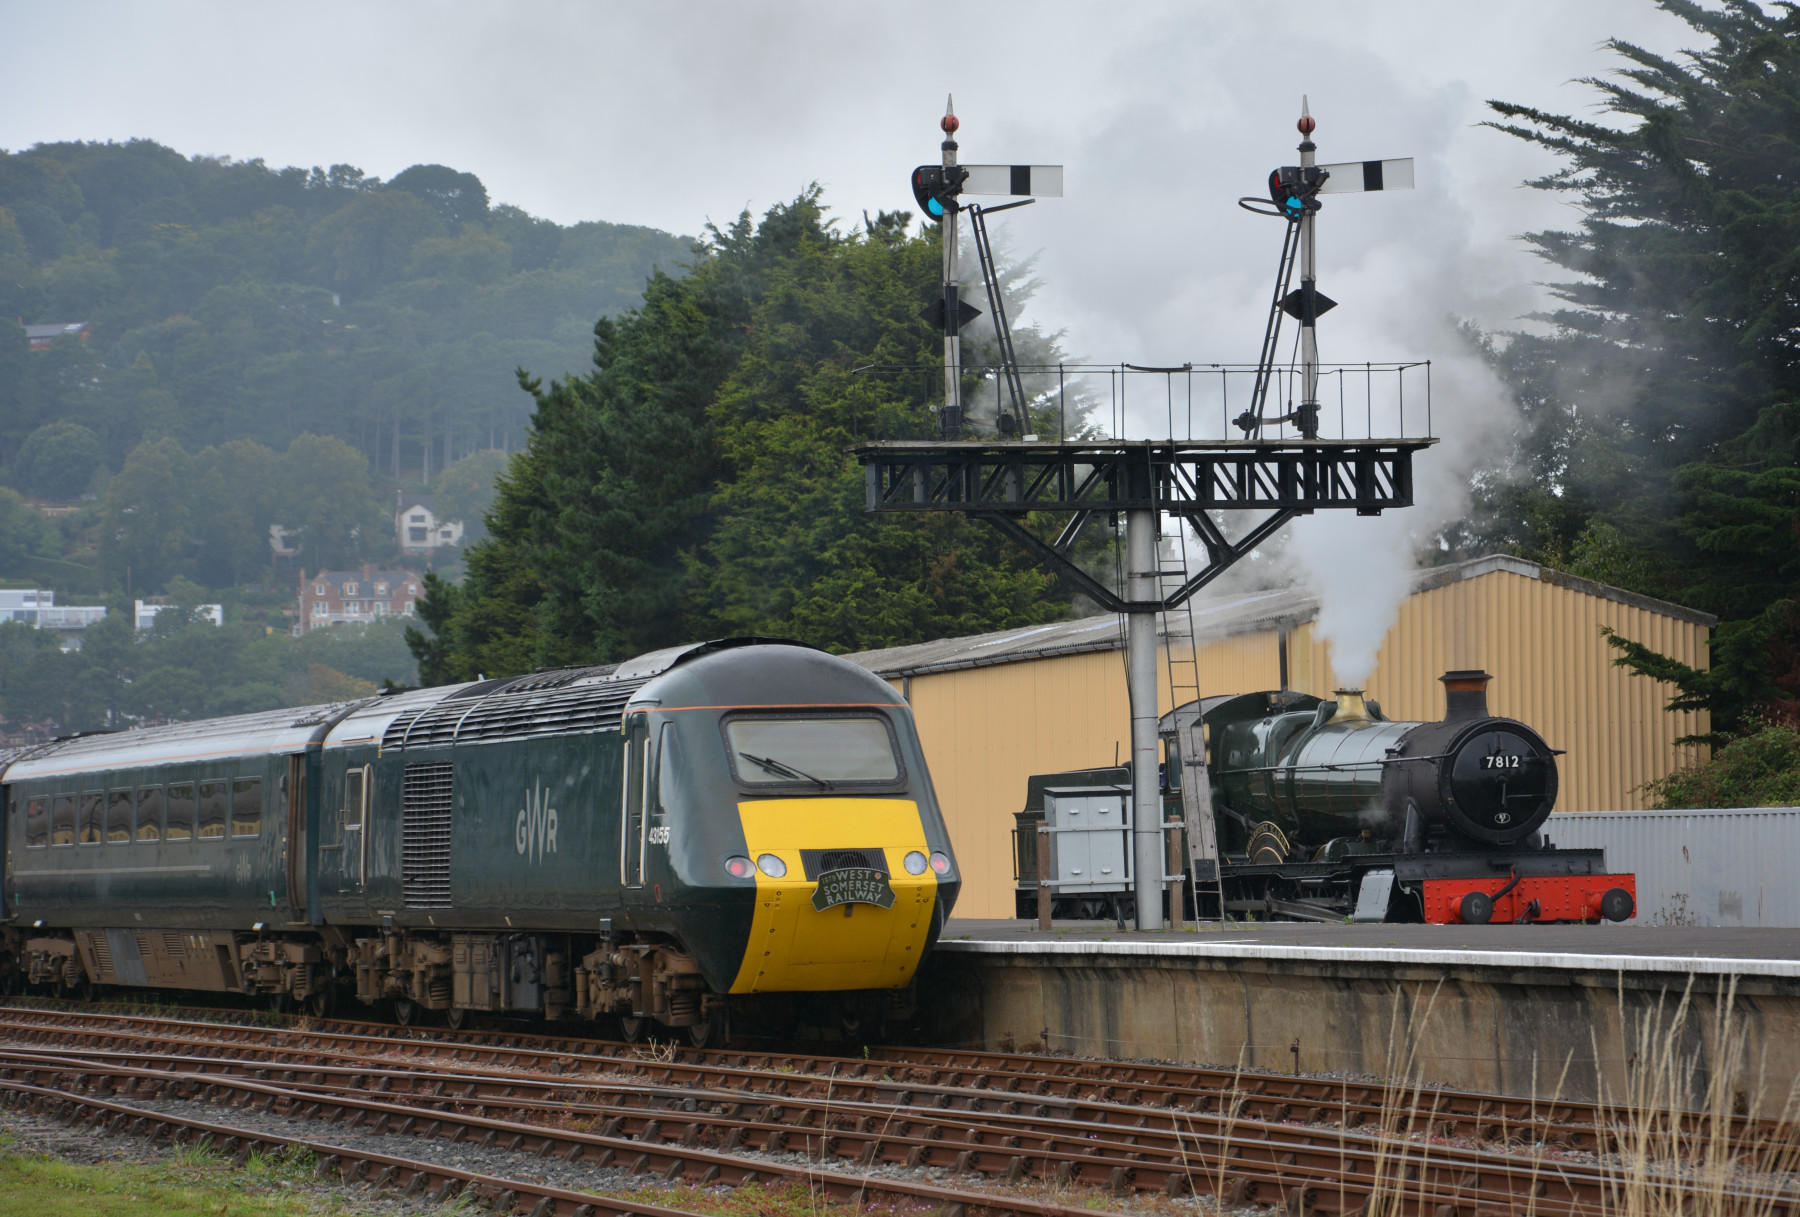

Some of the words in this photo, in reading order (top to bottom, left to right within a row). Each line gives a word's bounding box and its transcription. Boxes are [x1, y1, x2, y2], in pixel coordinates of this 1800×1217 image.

[1486, 755, 1519, 768] 7812
[516, 774, 558, 867] GWR
[822, 875, 836, 884] 1979
[836, 870, 871, 880] WEST
[823, 881, 884, 895] SOMERSET
[826, 890, 881, 905] RAILWAY
